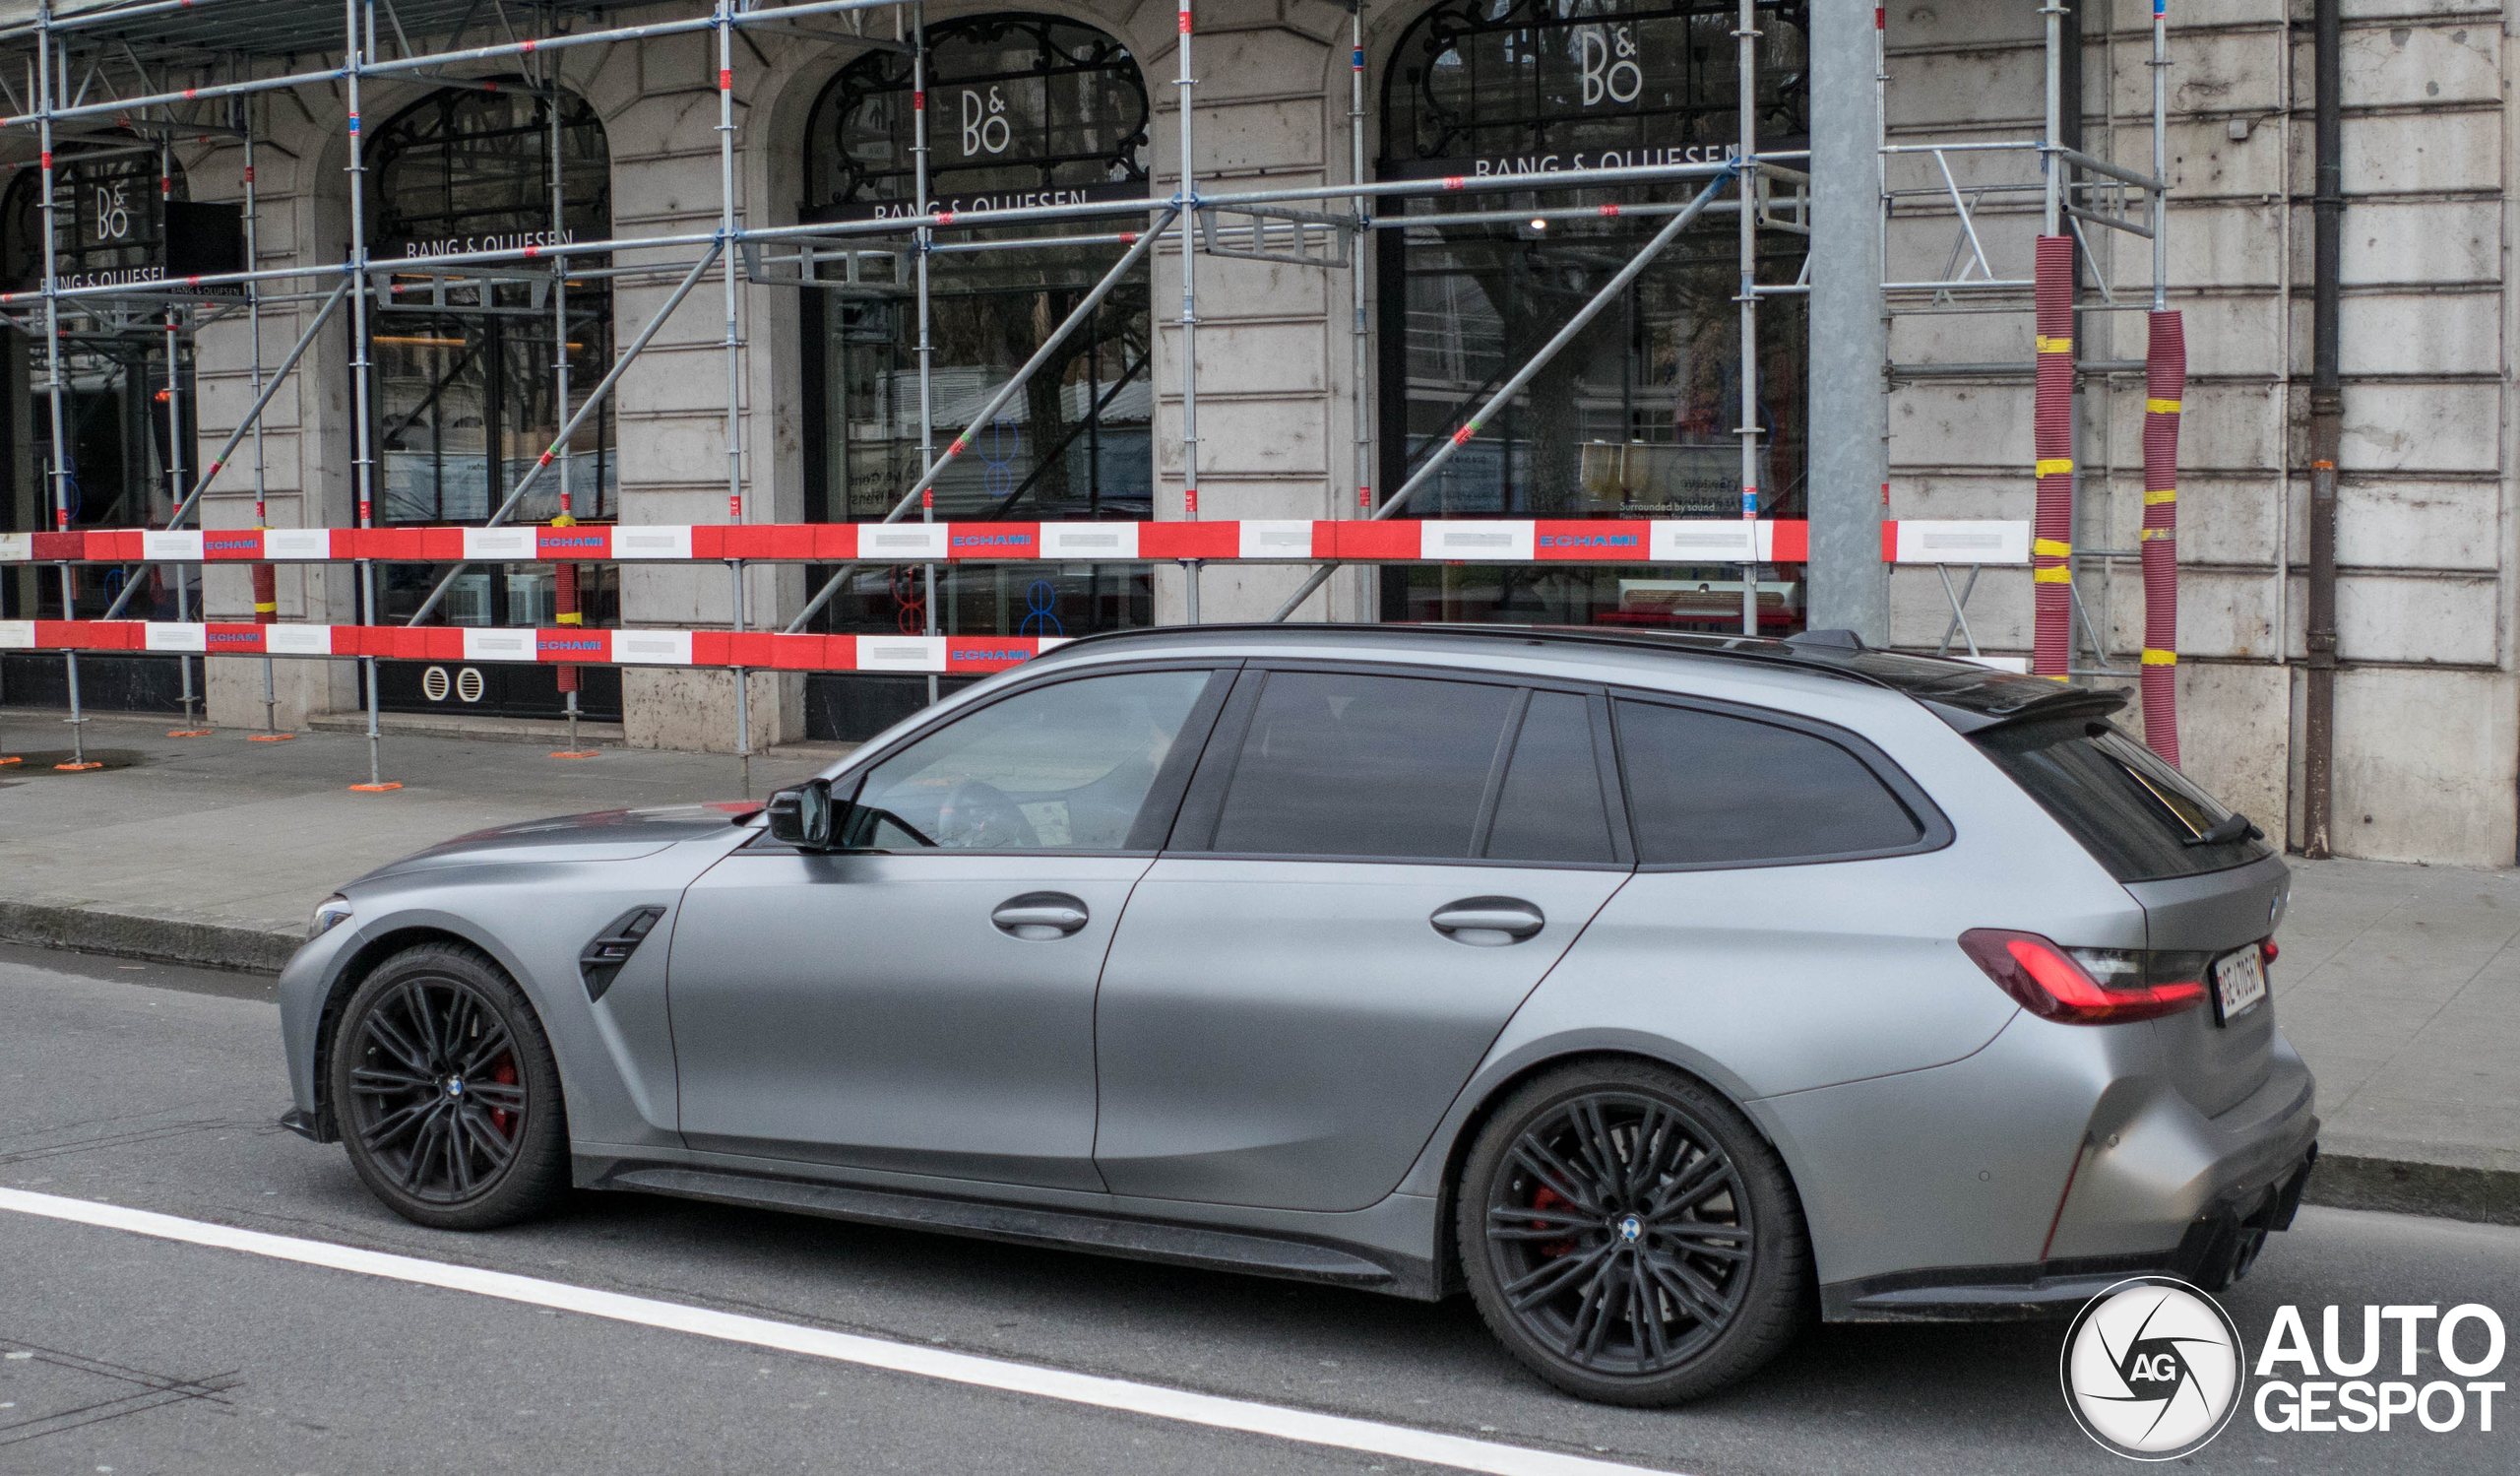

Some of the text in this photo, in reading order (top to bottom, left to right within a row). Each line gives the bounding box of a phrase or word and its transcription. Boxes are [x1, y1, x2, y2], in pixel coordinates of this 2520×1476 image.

[1476, 155, 1559, 177] BANG
[1573, 153, 1589, 171] &
[407, 238, 459, 259] BANG
[467, 237, 477, 254] &
[87, 273, 96, 288] &
[170, 286, 194, 294] BANG
[1619, 502, 1716, 513] Surrounded by sound
[206, 540, 258, 549] ECHAMI
[539, 537, 603, 546] ECHAMI
[953, 535, 1032, 546] ECHAMI
[1540, 535, 1638, 546] ECHAMI
[209, 633, 260, 642] ECHAMI
[537, 641, 601, 650] ECHAMI
[952, 650, 1031, 661] ECHAMI
